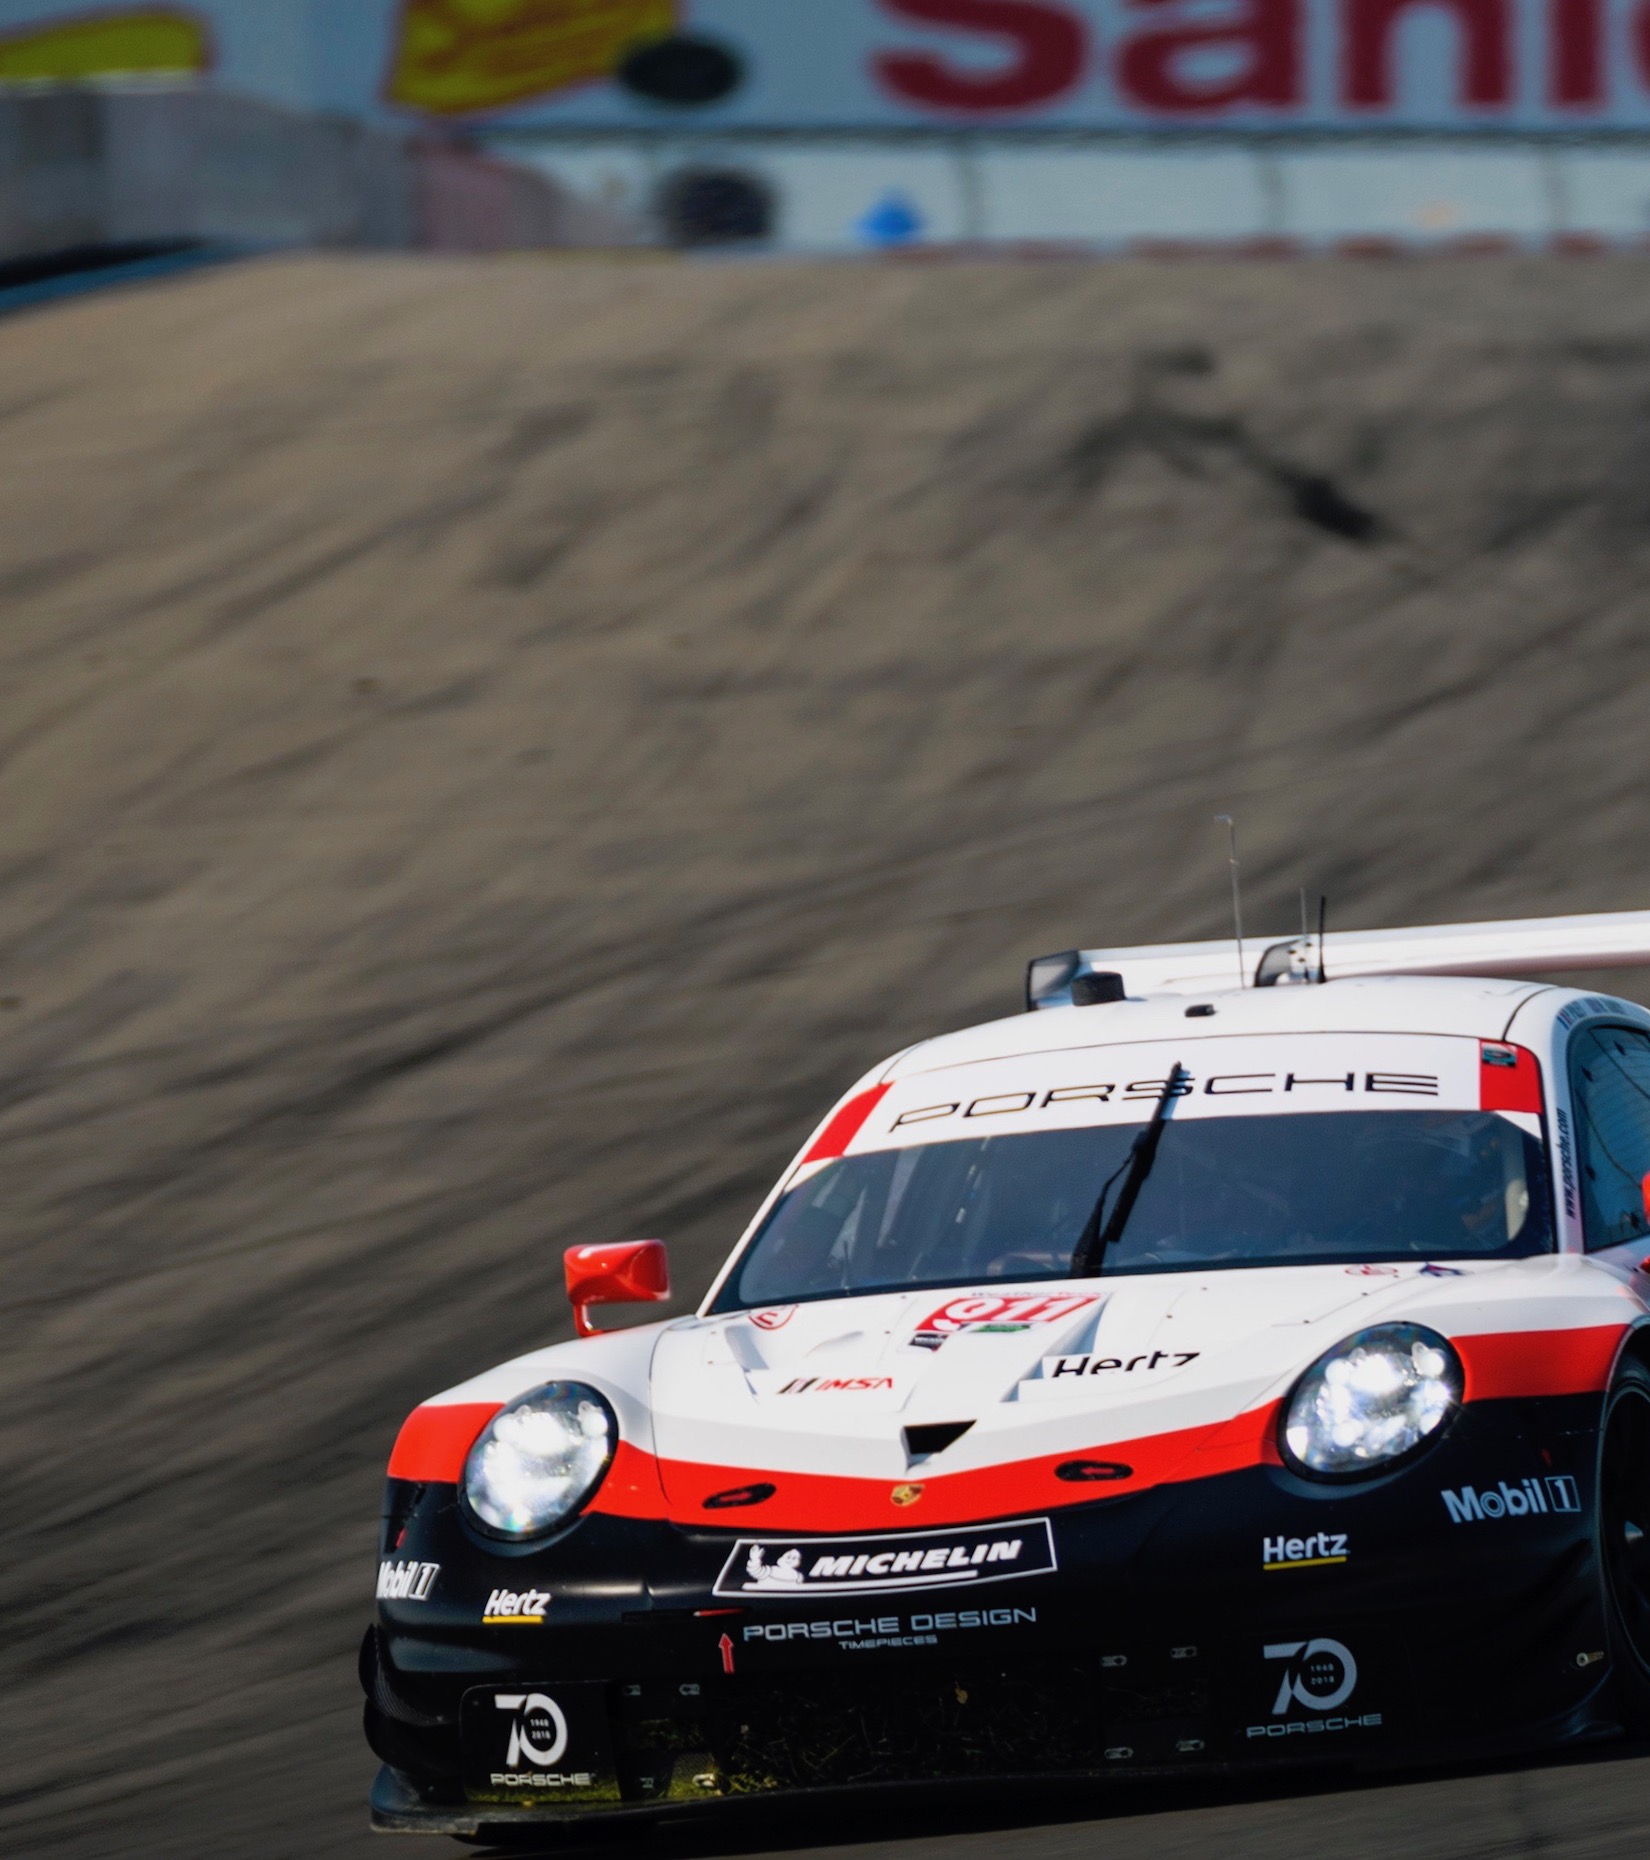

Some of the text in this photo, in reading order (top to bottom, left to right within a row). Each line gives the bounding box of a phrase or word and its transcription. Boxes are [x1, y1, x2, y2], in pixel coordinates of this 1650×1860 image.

[889, 1072, 1438, 1133] PORSCHE
[1556, 1107, 1576, 1219] www.porsche.com
[932, 1297, 1092, 1331] 911
[1052, 1350, 1200, 1379] Hertz
[1441, 1479, 1548, 1523] Mobil
[809, 1539, 1023, 1578] MICHELIN
[1263, 1532, 1348, 1563] Hertz
[376, 1560, 438, 1600] Mobil 1
[484, 1588, 551, 1617] Hertz
[743, 1607, 1037, 1642] PORSCHE DESIGN
[838, 1634, 938, 1650] TIMEPIECES
[1246, 1713, 1383, 1738] PORSCHE
[490, 1772, 592, 1786] PORSCHE
